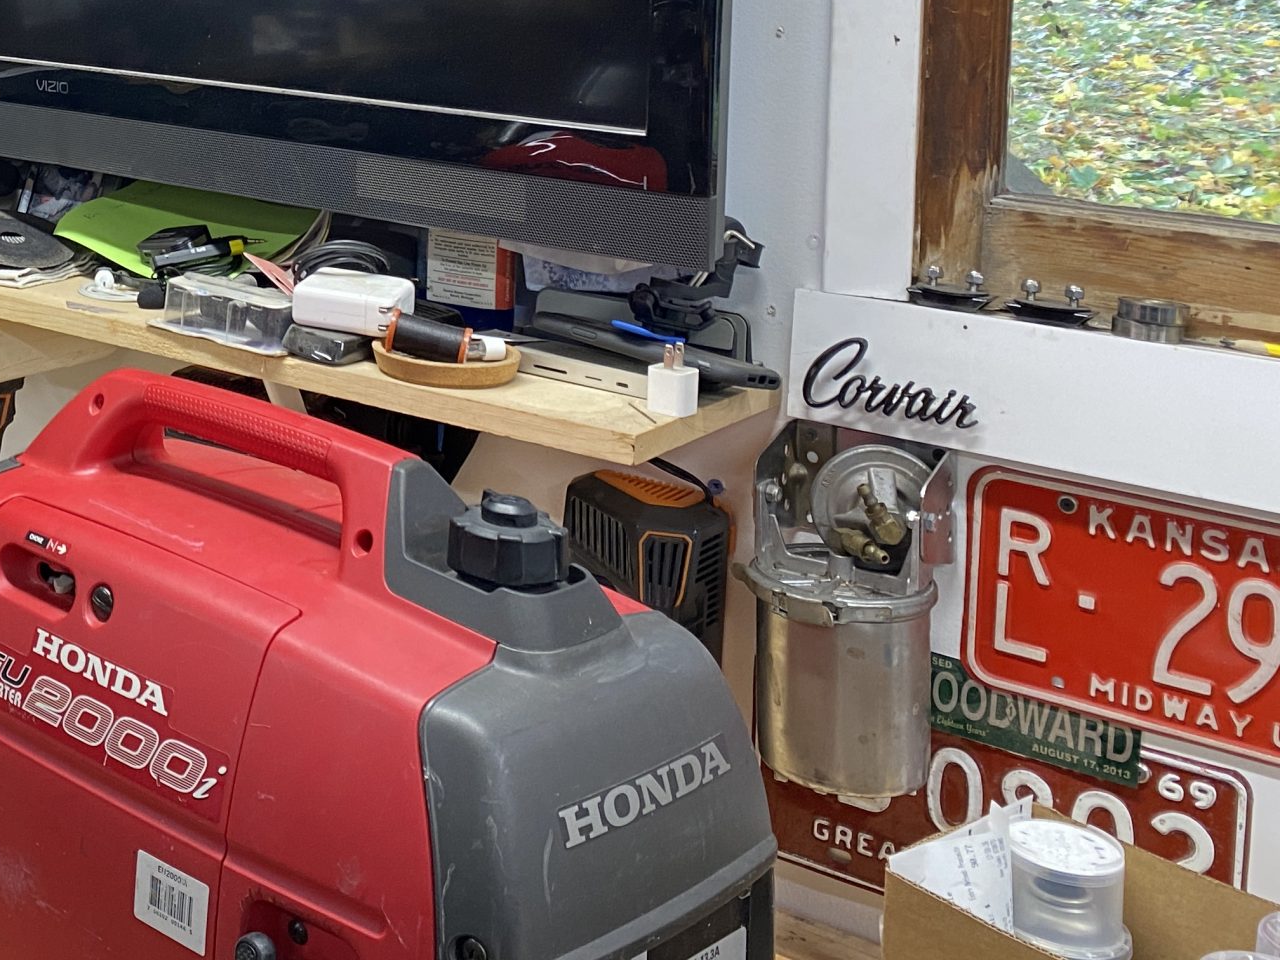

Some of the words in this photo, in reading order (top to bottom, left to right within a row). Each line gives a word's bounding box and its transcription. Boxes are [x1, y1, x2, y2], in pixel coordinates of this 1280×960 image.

[36, 79, 69, 94] VIZIO
[803, 337, 978, 429] Corvair
[33, 628, 169, 716] HONDA
[1090, 672, 1252, 737] MIDWAY
[1032, 744, 1080, 764] AUGUST
[1083, 759, 1100, 772] 17,
[1103, 764, 1131, 780] 2013
[1157, 773, 1217, 809] 69
[558, 741, 731, 849] HONDA
